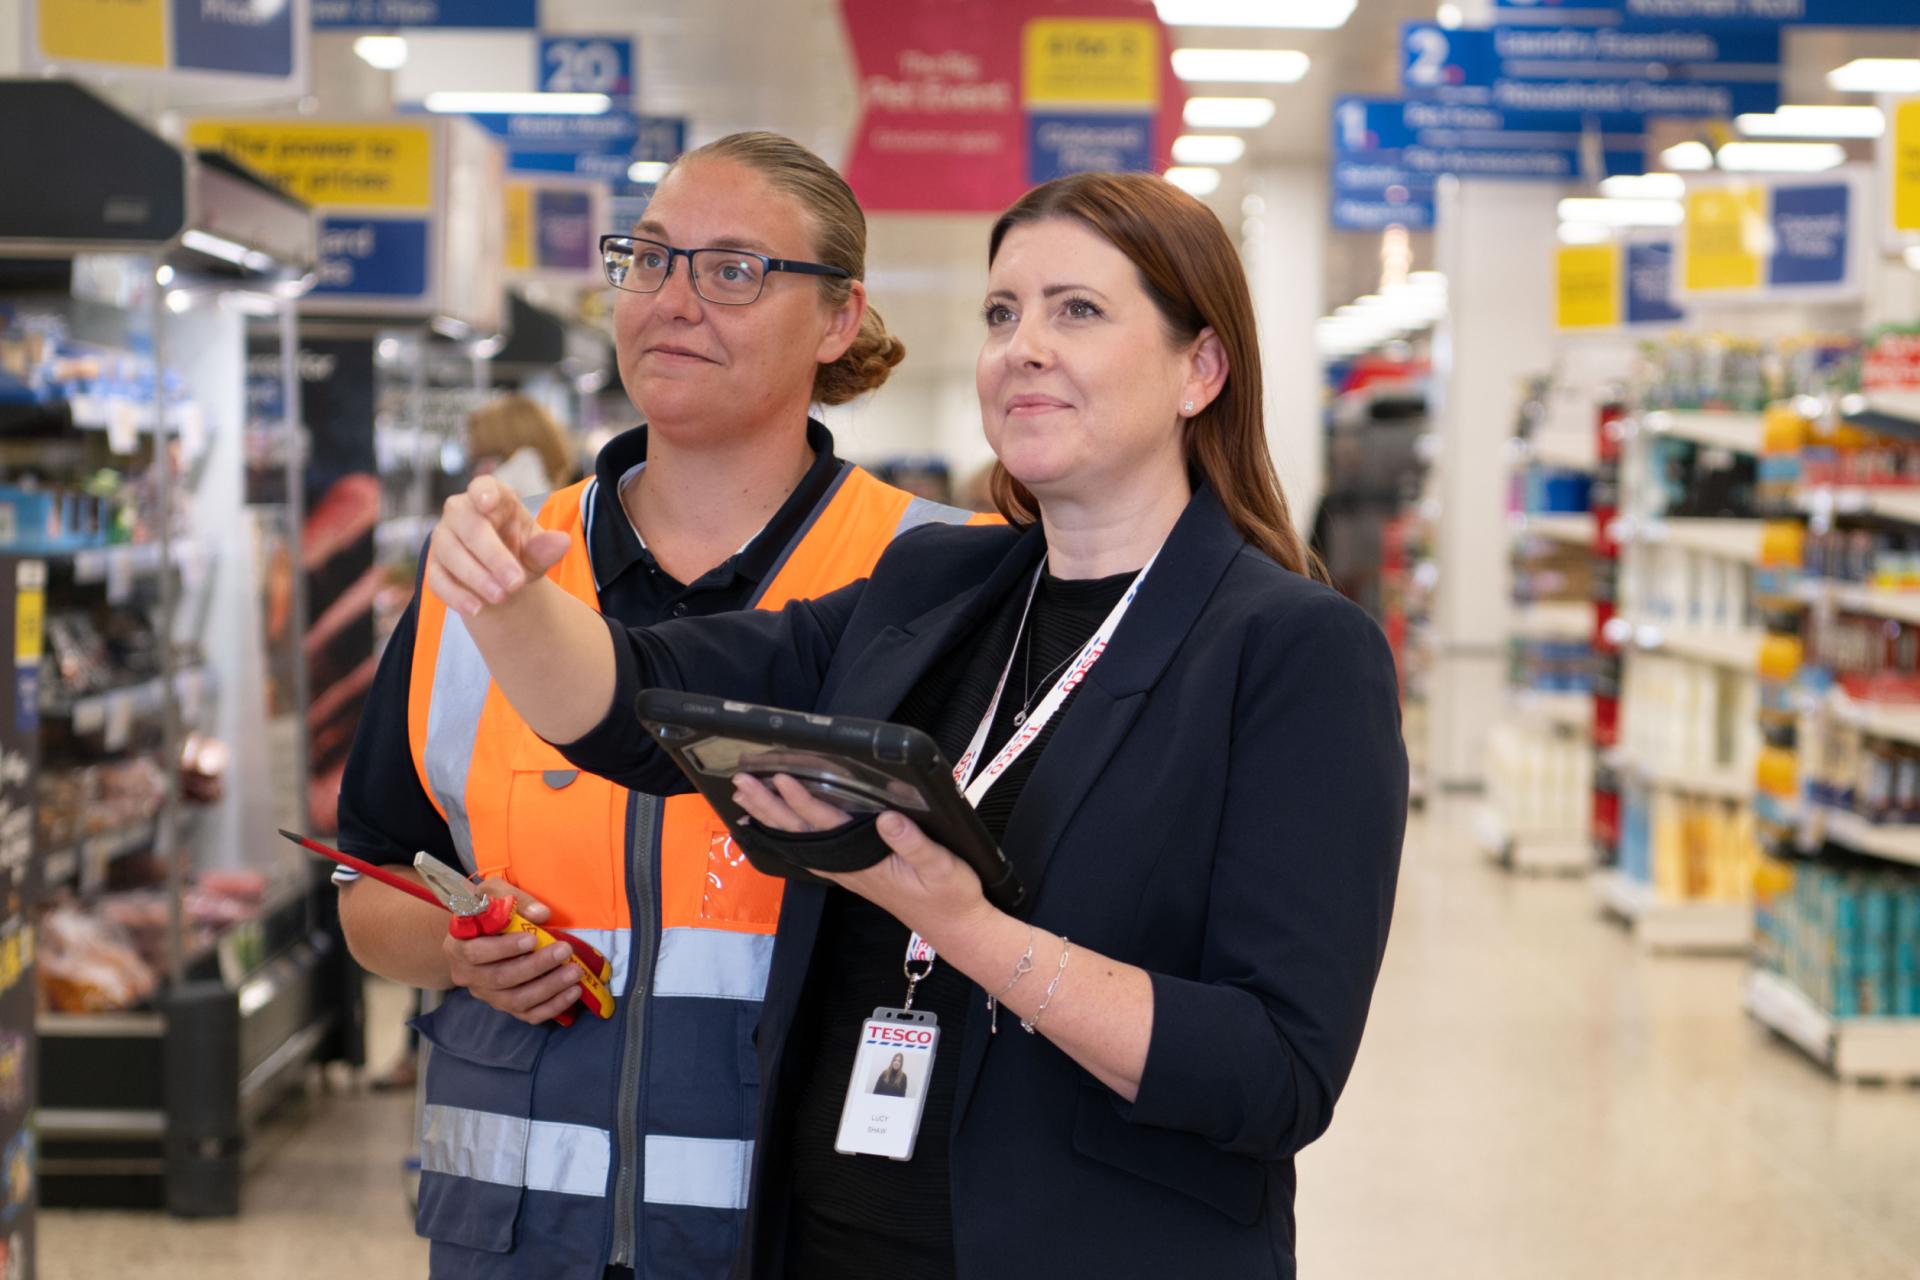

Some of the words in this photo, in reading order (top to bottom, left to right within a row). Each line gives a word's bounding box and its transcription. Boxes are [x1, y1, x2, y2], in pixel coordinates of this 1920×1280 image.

[545, 44, 618, 92] 20
[1406, 29, 1449, 84] 2
[1339, 104, 1365, 147] 1
[279, 138, 355, 163] power
[371, 138, 395, 159] to
[310, 168, 390, 191] prices
[990, 727, 1039, 775] TESCO
[868, 1025, 932, 1044] TESCO
[871, 1114, 889, 1122] LUCY
